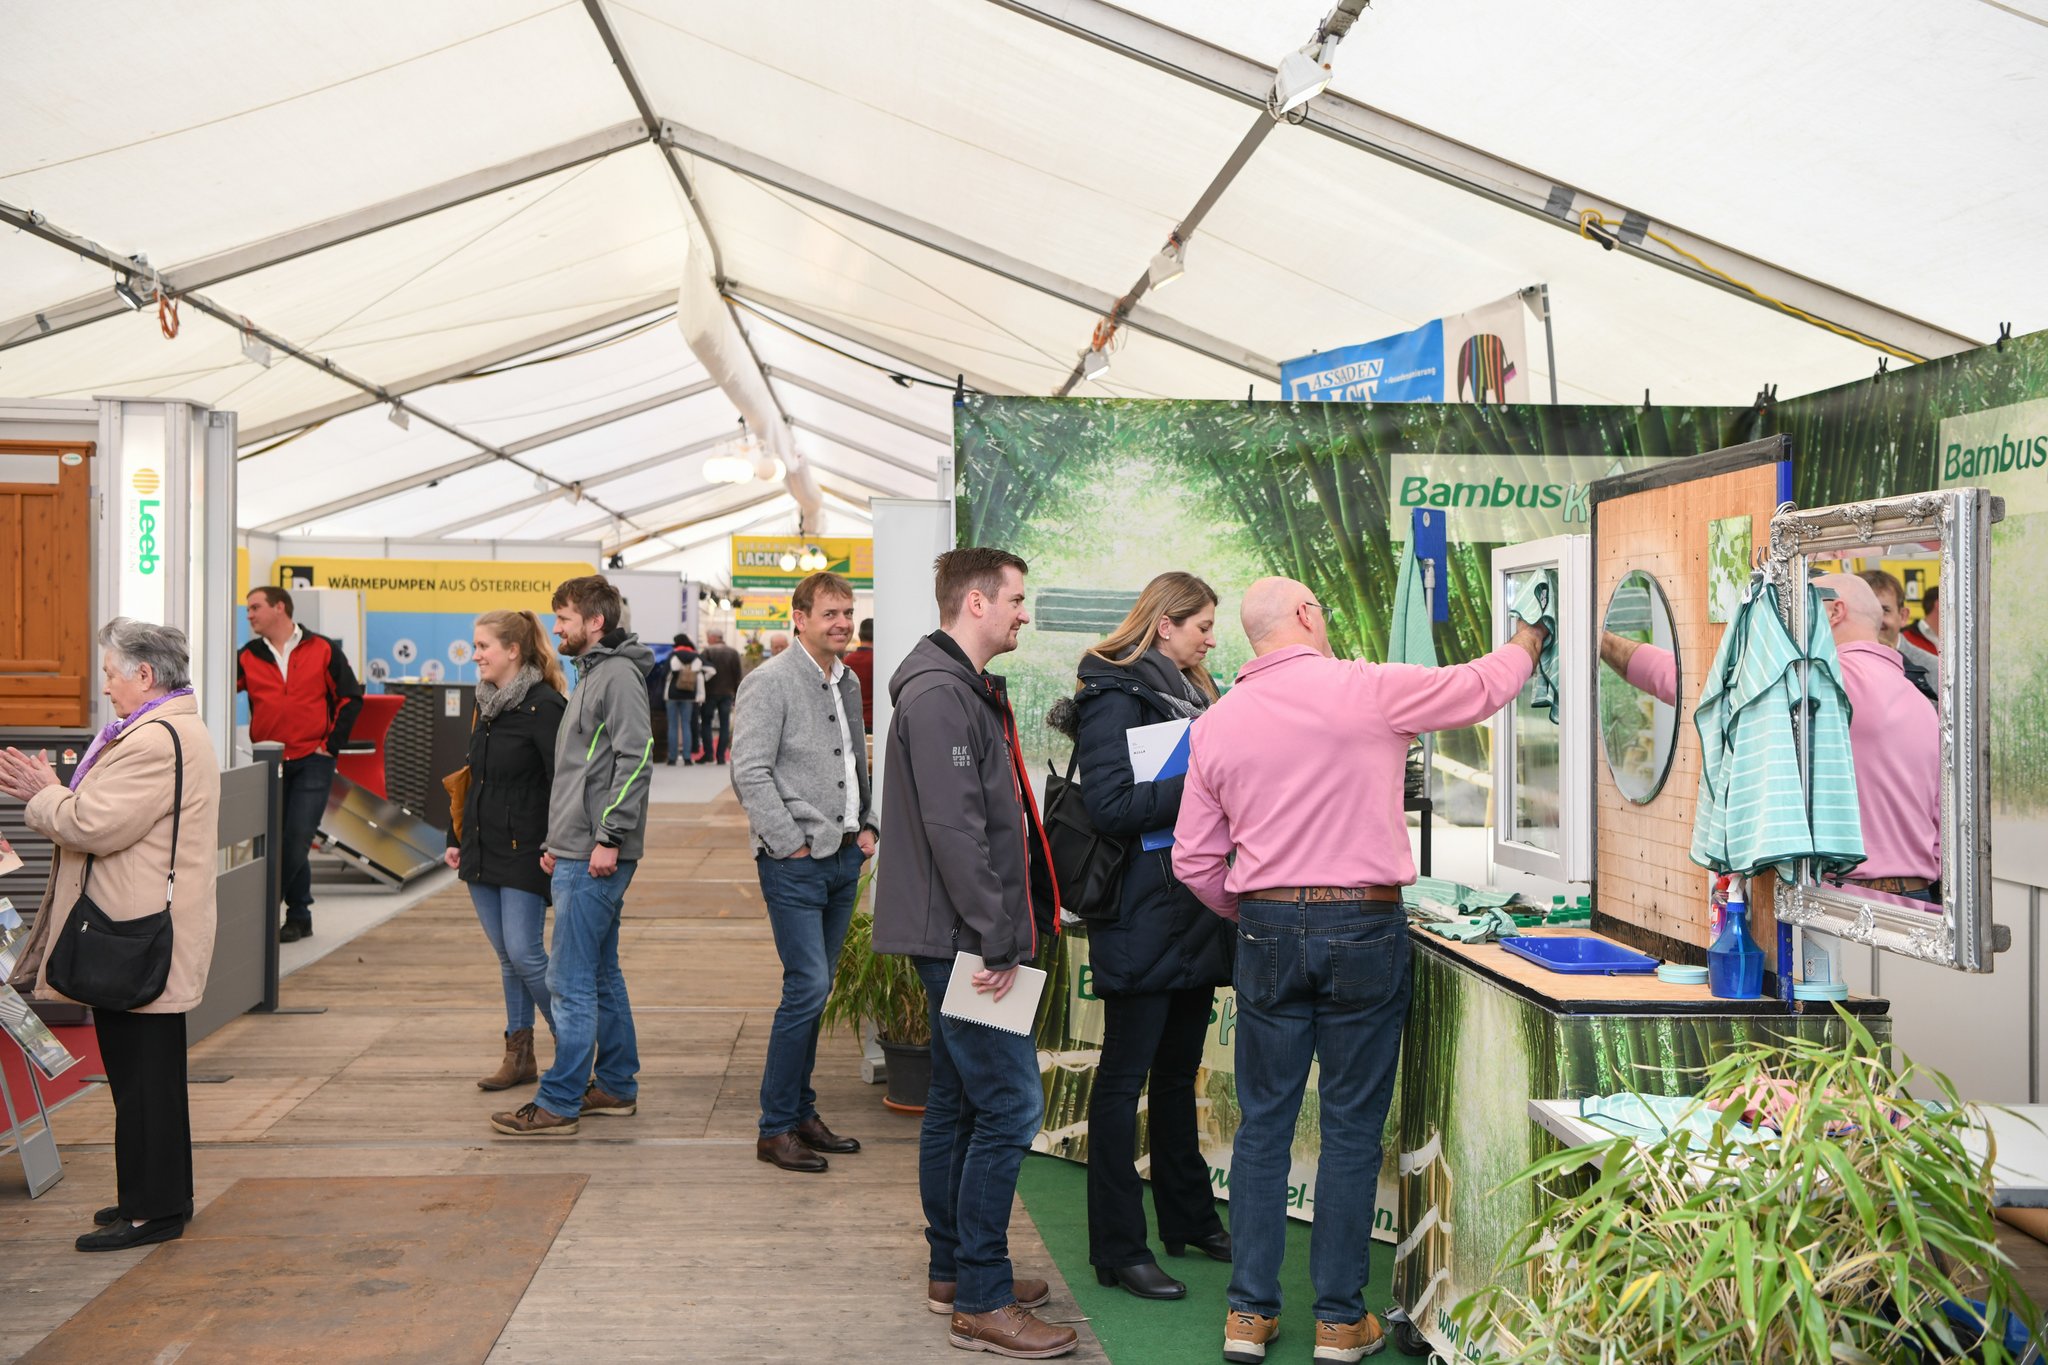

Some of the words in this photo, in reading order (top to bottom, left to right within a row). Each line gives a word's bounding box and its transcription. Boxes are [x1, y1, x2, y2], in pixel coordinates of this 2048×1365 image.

[1944, 433, 2048, 481] Bambus
[139, 500, 160, 575] Leeb
[328, 574, 436, 591] WÄRMEPUMPEN
[440, 579, 466, 591] AUS
[470, 577, 552, 592] ÖSTERREICH
[952, 745, 968, 755] BLK
[1296, 887, 1365, 900] EANS
